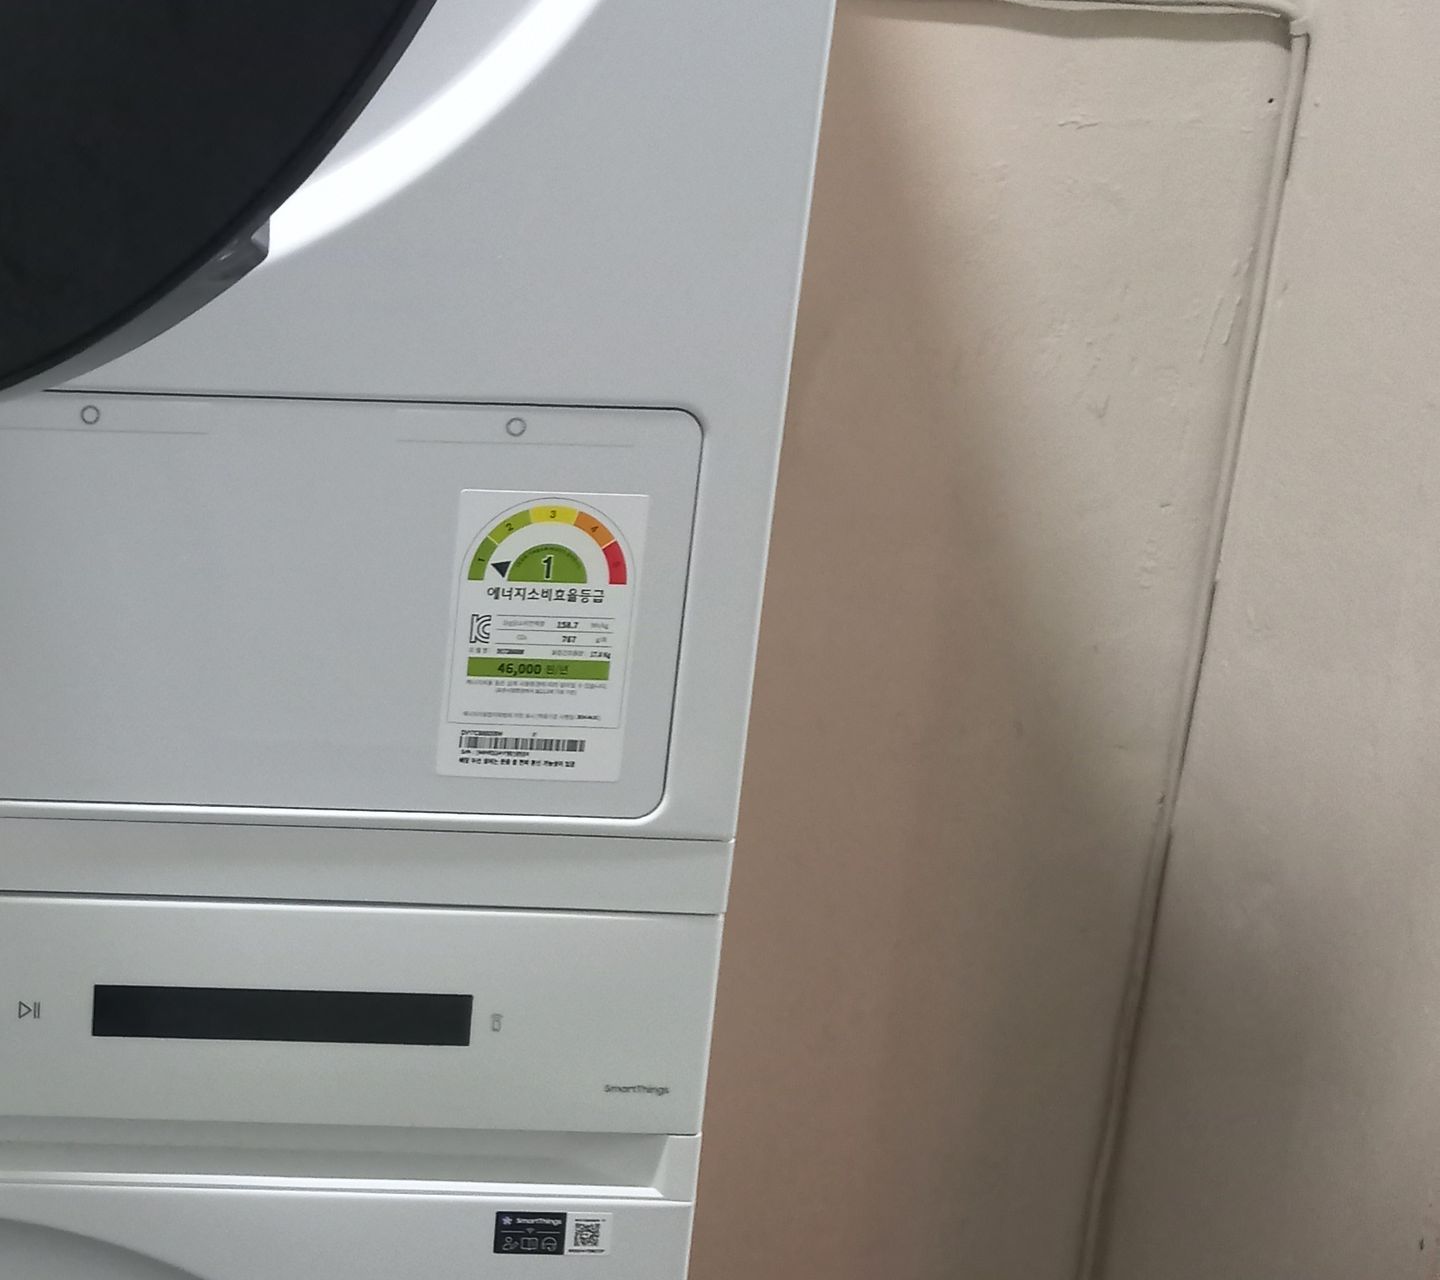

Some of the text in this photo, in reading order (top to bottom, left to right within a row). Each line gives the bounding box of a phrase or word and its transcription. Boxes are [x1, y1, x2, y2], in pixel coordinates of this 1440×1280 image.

[549, 509, 557, 519] 3
[505, 522, 515, 532] 2
[541, 554, 554, 581] 1
[486, 586, 605, 604] 에너지소비효율등급
[497, 662, 542, 677] 46,000
